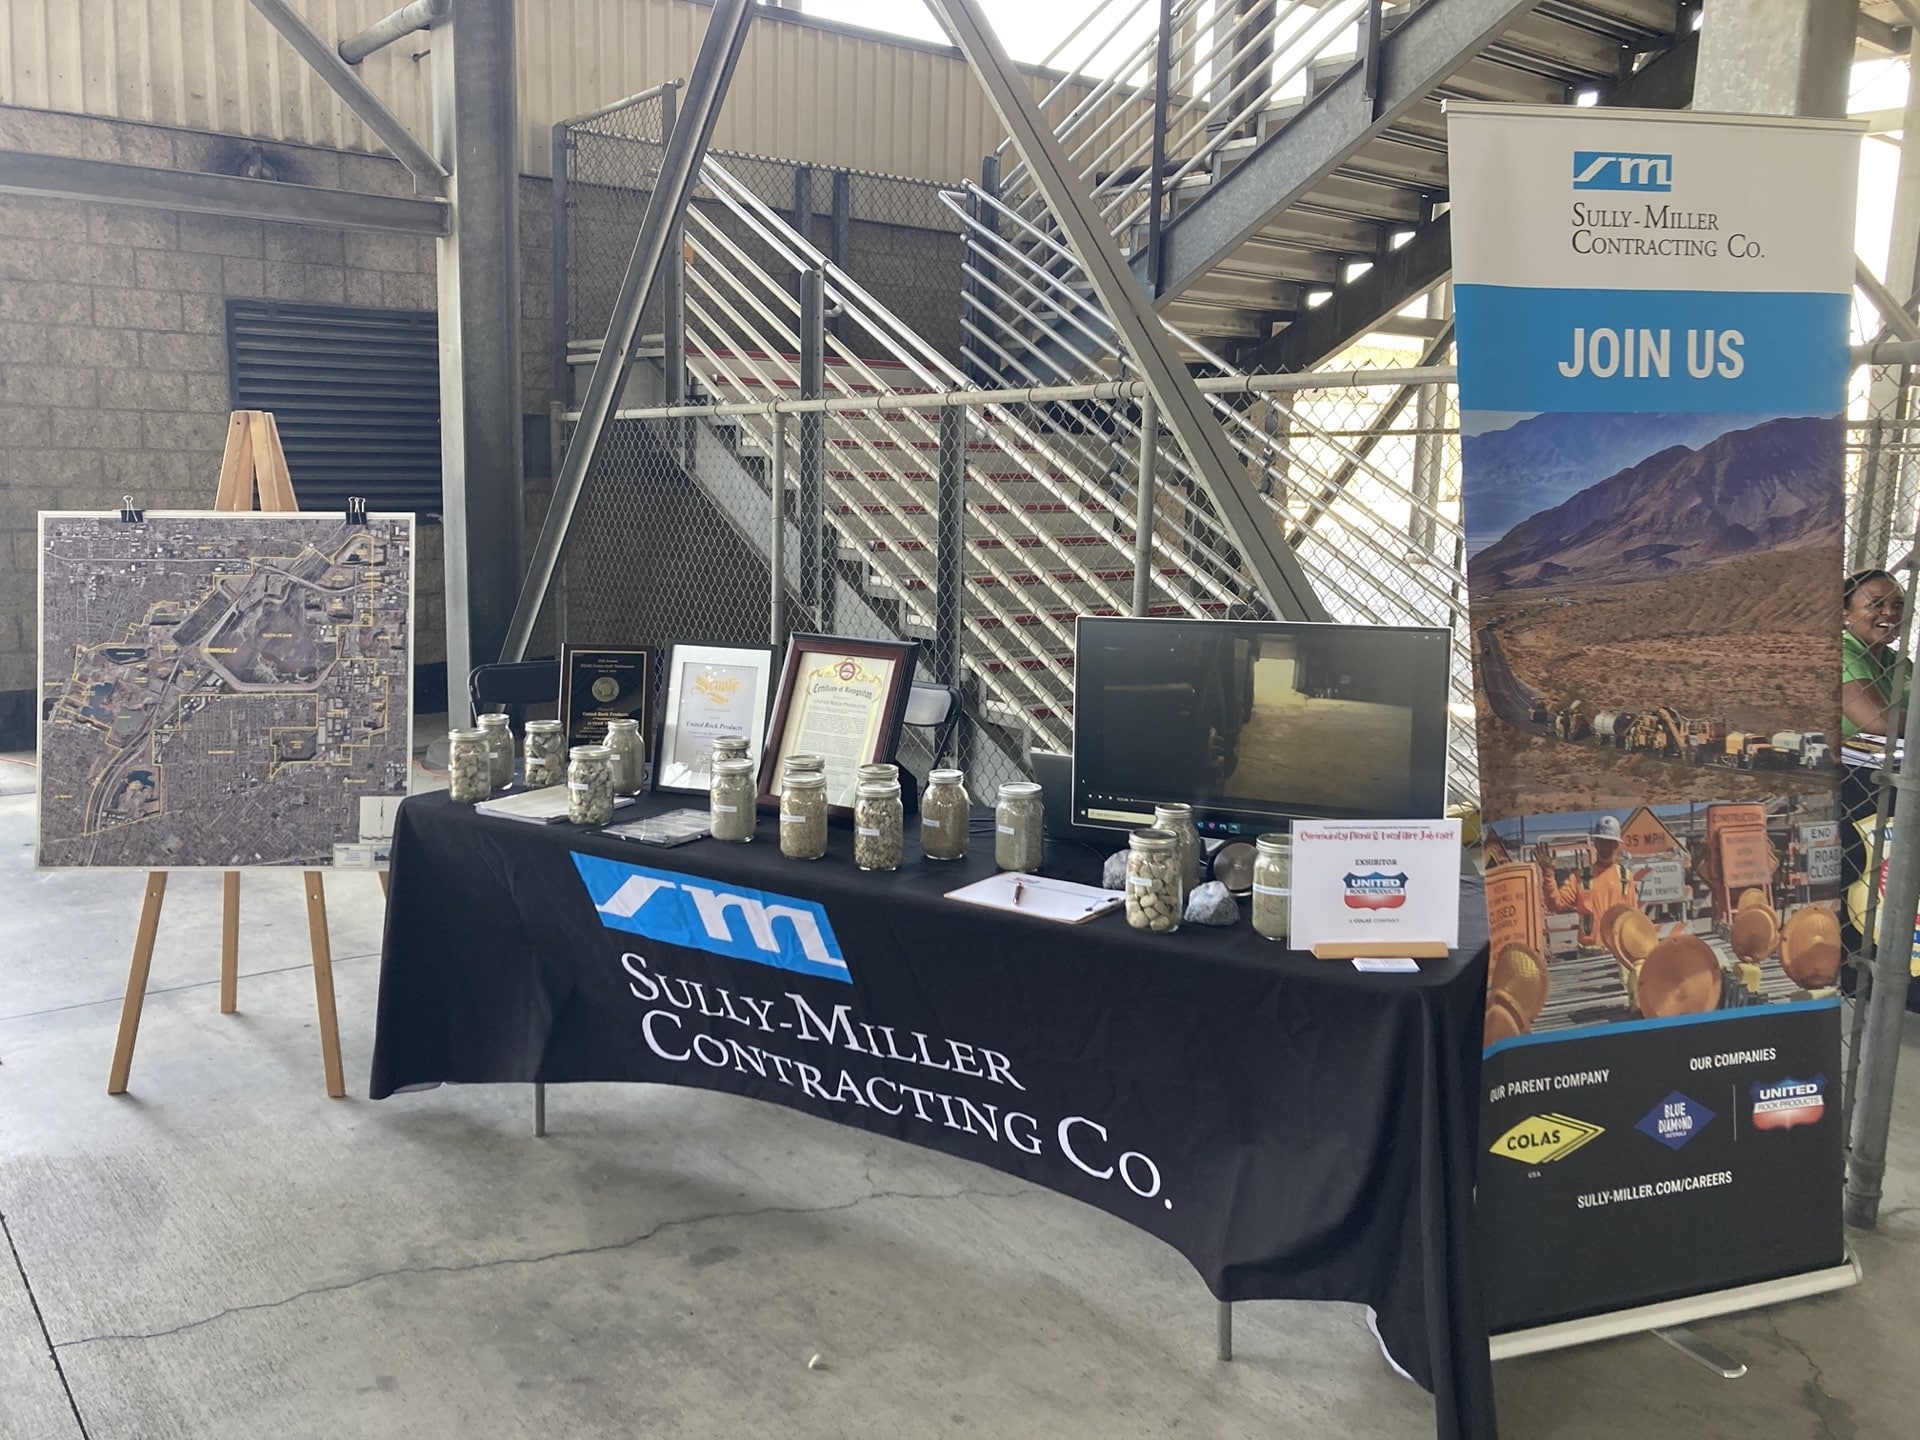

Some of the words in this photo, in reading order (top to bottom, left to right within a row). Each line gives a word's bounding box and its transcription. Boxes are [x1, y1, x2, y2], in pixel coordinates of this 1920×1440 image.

[1571, 202, 1719, 231] SULLY-MILLER
[1571, 229, 1717, 257] CONTRACTING
[1727, 233, 1765, 258] CO.
[1558, 327, 1671, 379] JOIN
[1687, 329, 1745, 379] US
[719, 723, 743, 731] Products
[1626, 835, 1639, 848] 35
[1644, 833, 1666, 846] MPH
[1811, 828, 1832, 839] END
[1811, 863, 1841, 878] CLOSE
[1351, 879, 1401, 887] UNITED
[620, 951, 1026, 1091] SULLY-MILLER
[1690, 1057, 1712, 1071] OUR
[1715, 1048, 1777, 1068] COMPANIES
[1490, 1085, 1506, 1103] OUR
[1508, 1078, 1552, 1096] PARENT
[1554, 1069, 1610, 1090] COMPANY
[1759, 1083, 1818, 1100] UNITED
[641, 1009, 1043, 1155] CONTRACTING
[1057, 1116, 1173, 1211] CO.
[1664, 1102, 1686, 1118] BLUE
[1758, 1101, 1779, 1112] ROCK
[1779, 1097, 1820, 1110] PRODUCTS
[1658, 1116, 1693, 1134] DIAMOND
[1507, 1130, 1561, 1151] COLAS
[1577, 1171, 1733, 1209] SULLY-MILLER.COM/CAREERS
